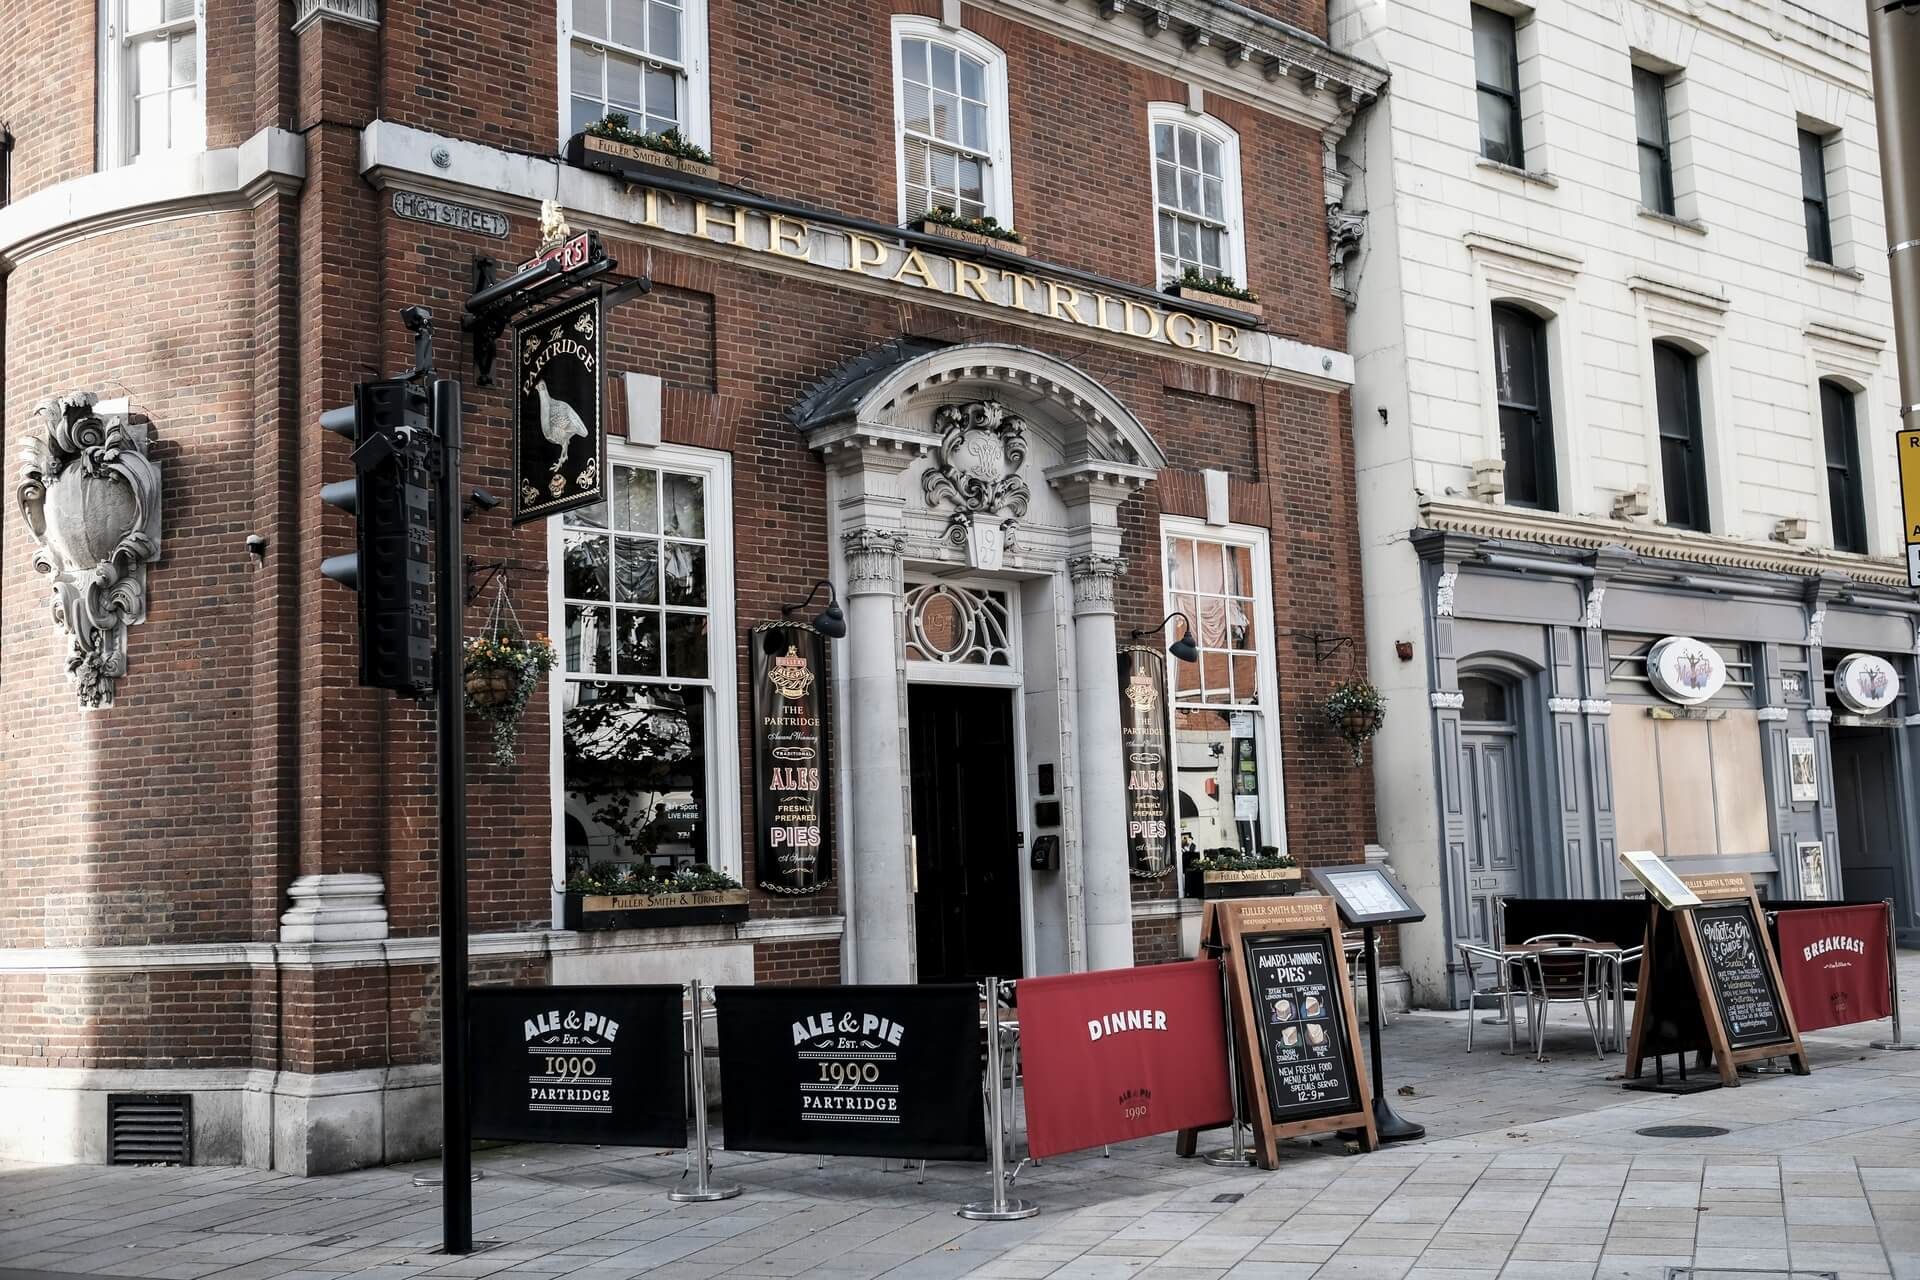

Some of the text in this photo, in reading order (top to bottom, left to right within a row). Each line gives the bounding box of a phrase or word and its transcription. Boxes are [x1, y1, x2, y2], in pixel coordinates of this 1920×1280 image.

[598, 140, 707, 176] FULLER SMITH & TURNER
[402, 195, 499, 233] HIGH STREET
[627, 184, 1241, 360] THE PARTRIDGE
[548, 324, 564, 343] The
[523, 339, 595, 395] PARTRIDGE
[782, 705, 804, 714] THE
[764, 717, 820, 727] PARTRIDGE
[769, 767, 820, 791] ALES
[1128, 770, 1165, 791] ALES
[775, 814, 817, 822] PREPARED
[770, 826, 821, 848] PIES
[1129, 820, 1167, 839] PIES
[1241, 871, 1259, 880] SMITH
[1260, 870, 1267, 879] &
[647, 895, 676, 908] SMITH
[680, 894, 689, 905] &
[692, 893, 724, 905] TURNER
[1241, 904, 1324, 917] FULLER SMITH & TURNER
[1803, 935, 1865, 962] BREAKFAST
[1259, 951, 1322, 969] AWARD-WINNING
[1277, 966, 1306, 983] PIES
[523, 1009, 620, 1043] ALE & PIE
[792, 1011, 905, 1047] ALE & PIE
[1088, 1009, 1168, 1041] DINNER
[545, 1056, 597, 1083] 1990
[818, 1062, 880, 1090] 1990
[1279, 1062, 1333, 1077] NEW FRESH FOOD
[1283, 1072, 1325, 1085] MENU & DAILY
[530, 1088, 611, 1102] PARTRIDGE
[1290, 1079, 1339, 1092] SPECIALS SERVED
[802, 1096, 898, 1111] PARTRIDGE
[1125, 1105, 1147, 1121] 1990
